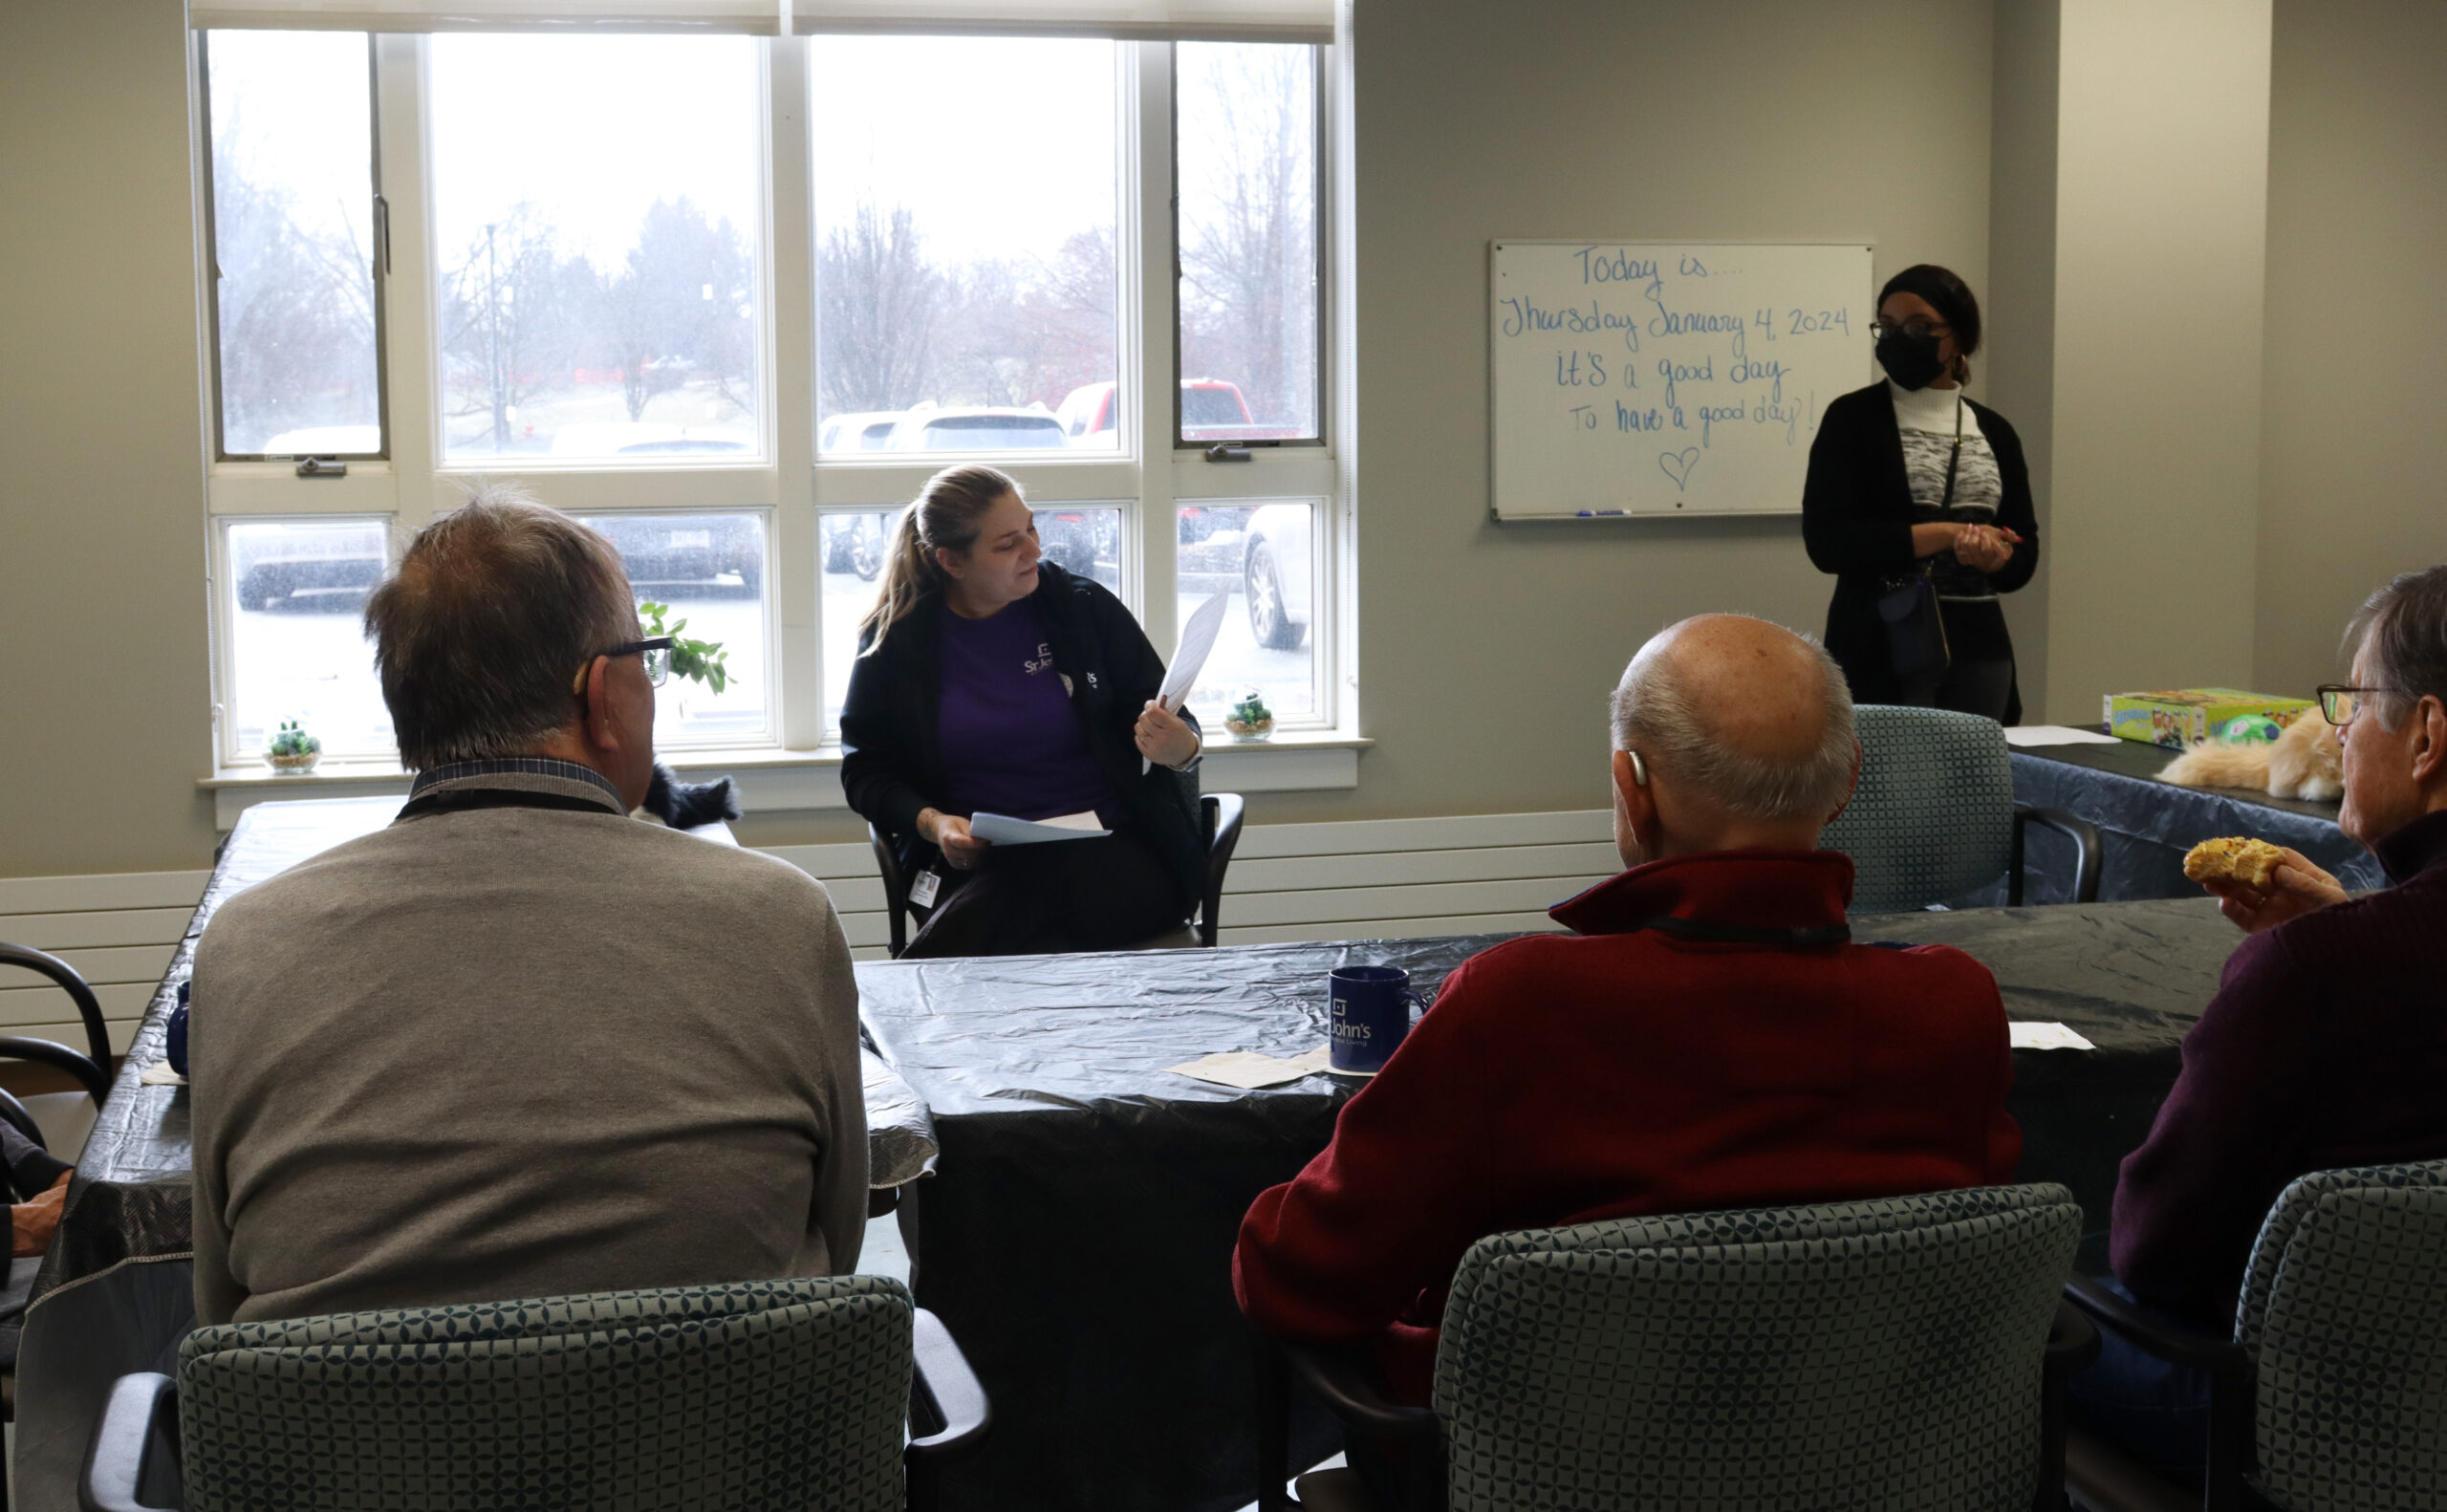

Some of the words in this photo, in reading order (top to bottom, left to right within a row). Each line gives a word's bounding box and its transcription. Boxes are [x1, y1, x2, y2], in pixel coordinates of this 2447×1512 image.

[1573, 245, 1663, 302] Today
[1499, 296, 1639, 353] Thursday
[1648, 301, 1745, 357] January
[1788, 307, 1850, 336] 2024
[1624, 363, 1640, 389] a
[1657, 356, 1713, 409] good
[1730, 356, 1791, 403] day
[1570, 404, 1597, 429] To
[1616, 400, 1663, 432] have
[1673, 405, 1688, 430] a
[1699, 398, 1745, 449] good
[1332, 1018, 1371, 1039] John's
